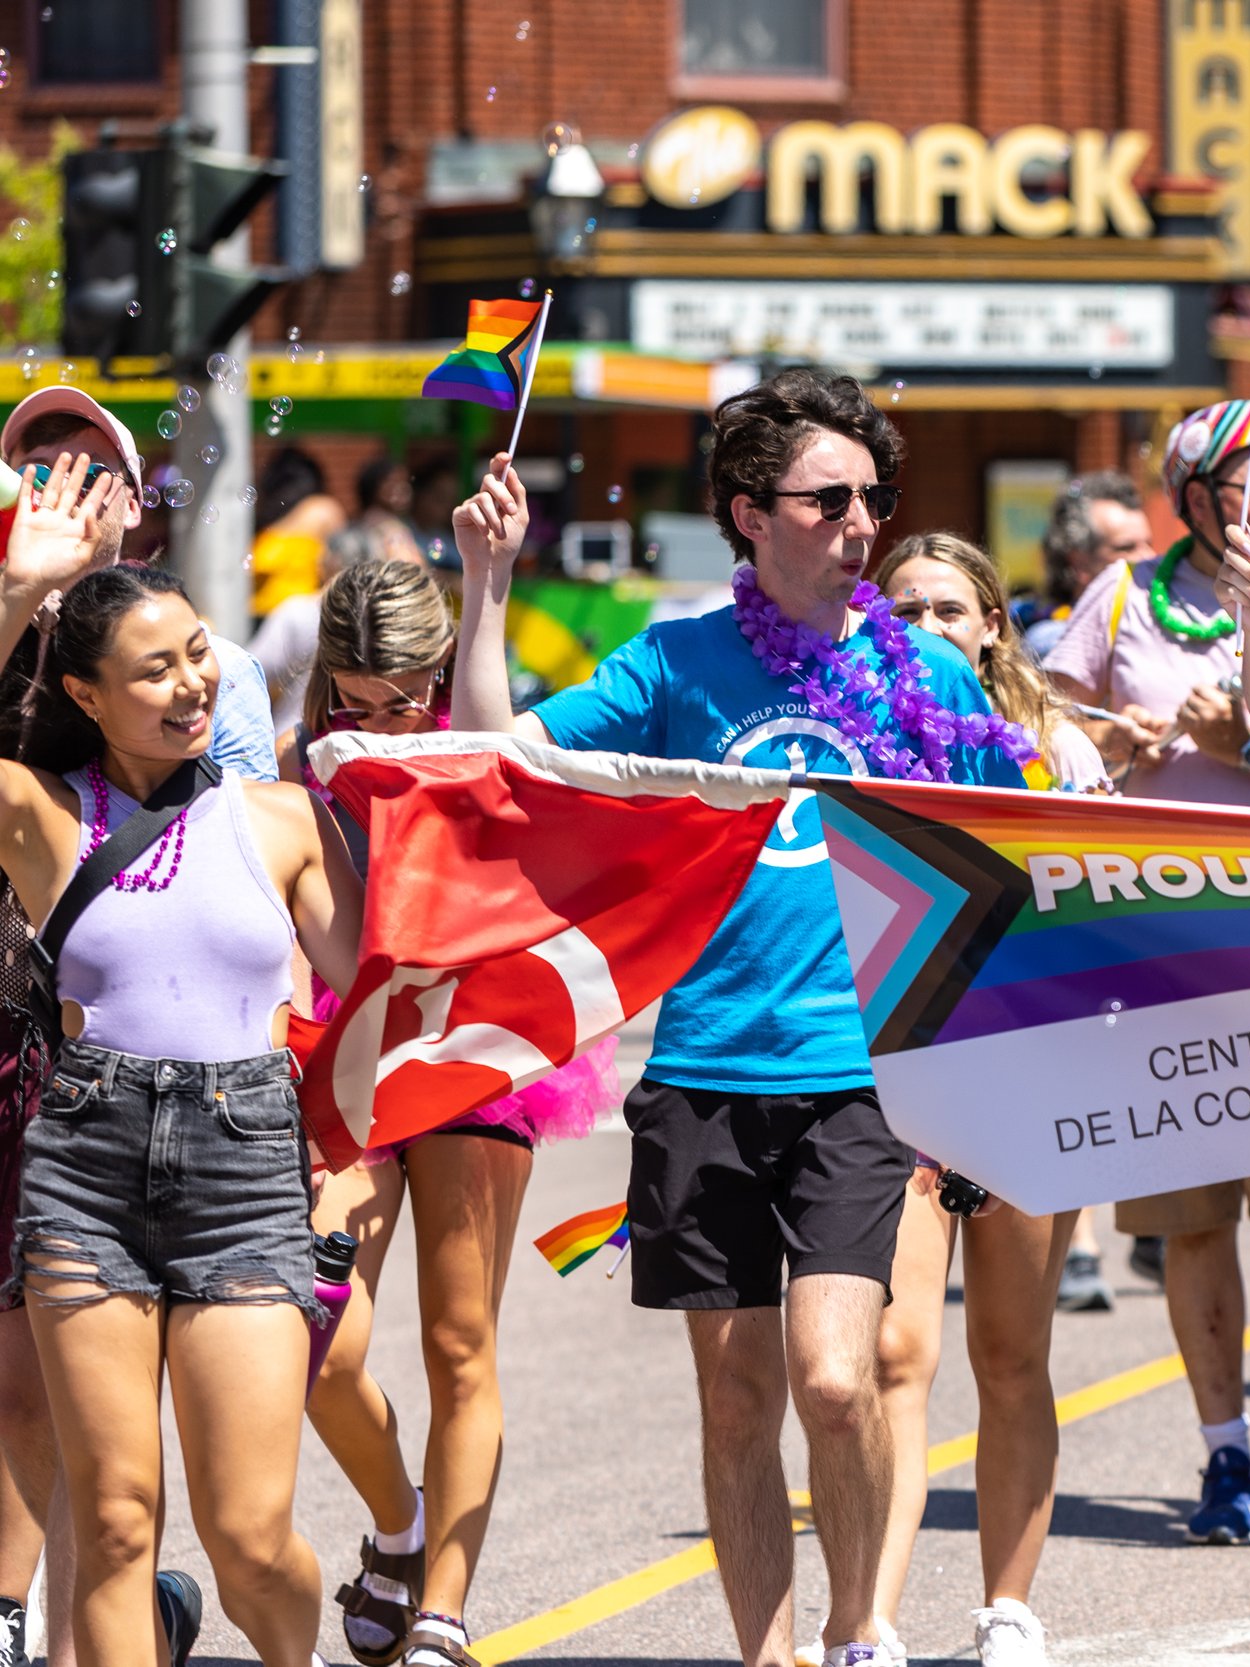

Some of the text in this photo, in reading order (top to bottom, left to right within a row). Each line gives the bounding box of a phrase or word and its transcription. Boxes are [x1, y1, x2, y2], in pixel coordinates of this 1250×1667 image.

[767, 119, 1156, 238] MACK
[716, 727, 738, 753] CAN
[735, 722, 743, 732] I
[741, 707, 773, 727] HELP
[1054, 1110, 1116, 1154] DE
[1128, 1097, 1183, 1138] LA
